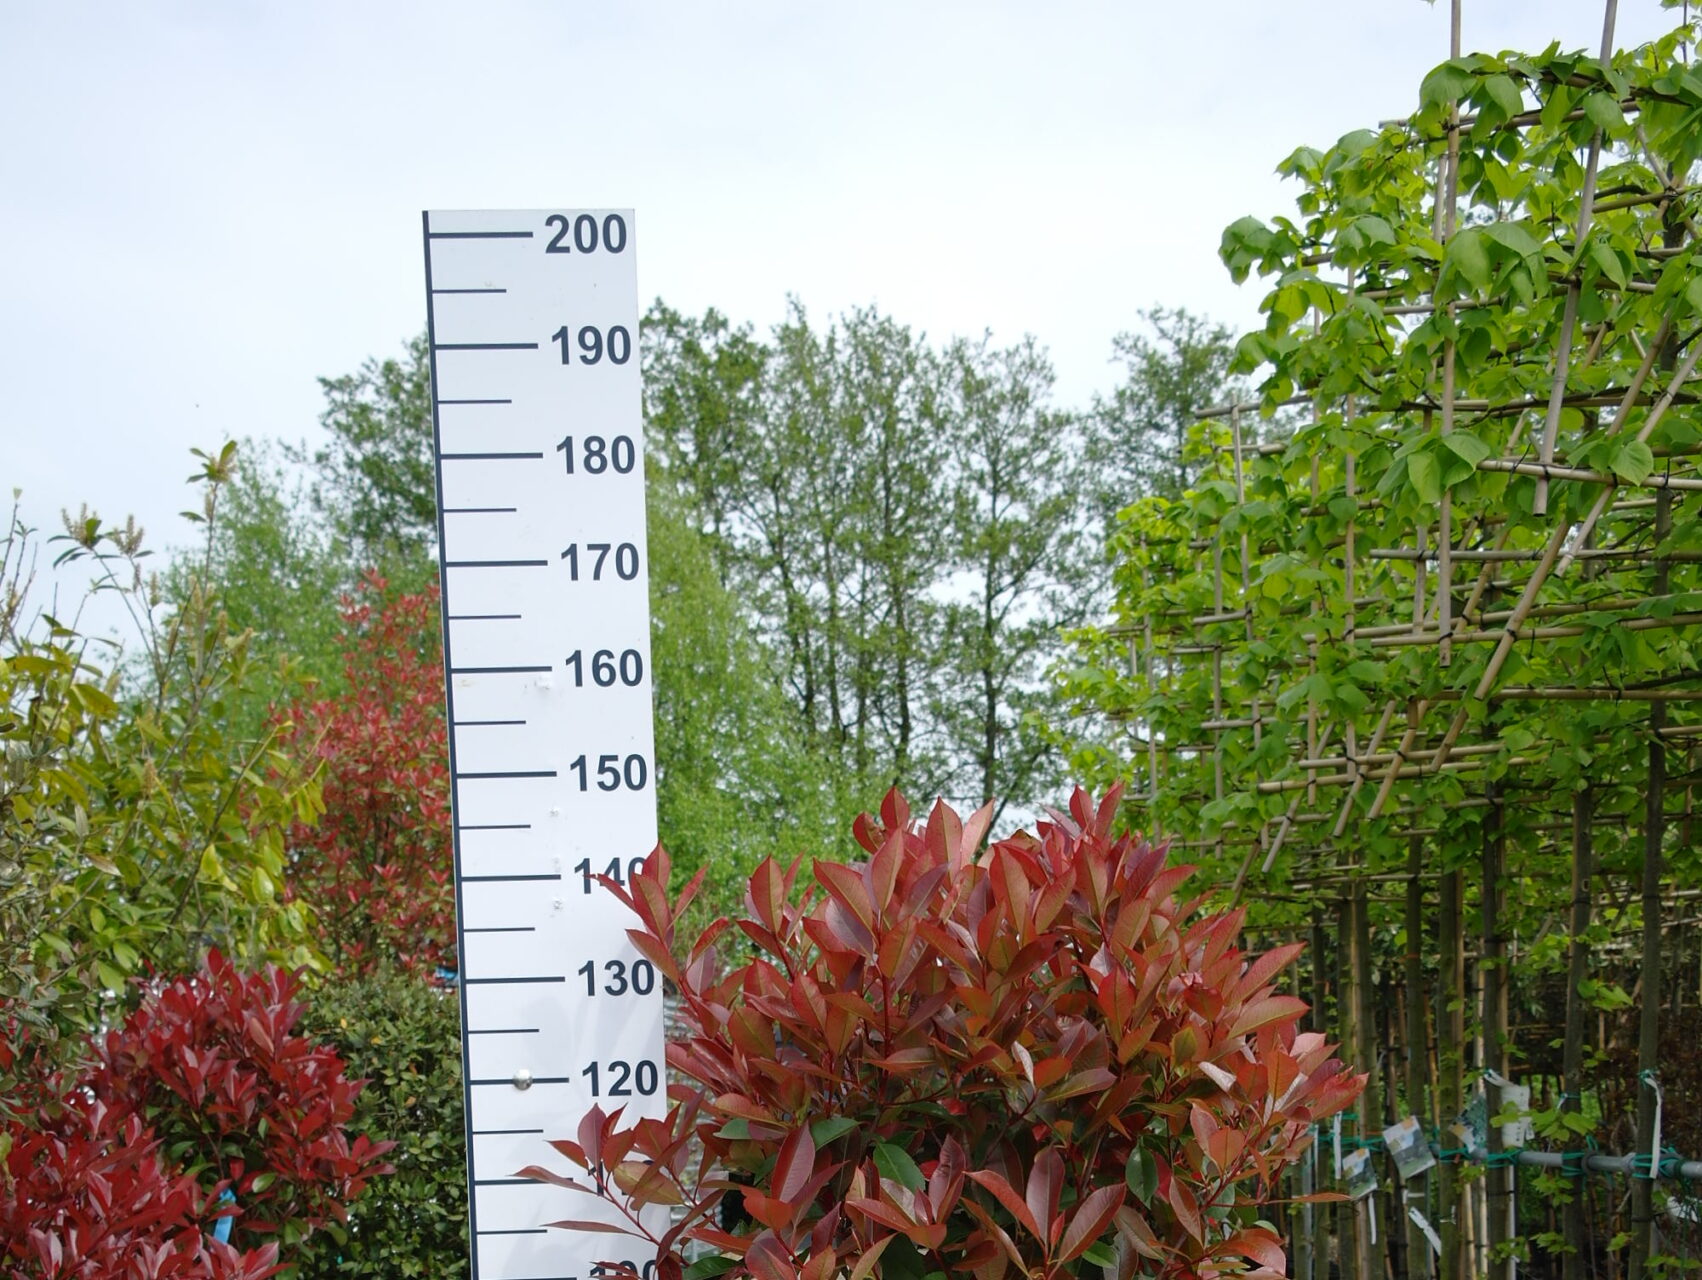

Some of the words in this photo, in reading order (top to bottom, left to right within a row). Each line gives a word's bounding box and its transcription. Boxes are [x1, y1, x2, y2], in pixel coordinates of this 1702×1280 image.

[545, 213, 627, 254] 200
[551, 325, 631, 365] 190
[556, 435, 635, 475] 180
[561, 542, 639, 581] 170
[565, 649, 643, 687] 160
[570, 753, 647, 792] 150
[577, 958, 656, 997] 130
[582, 1059, 659, 1097] 120
